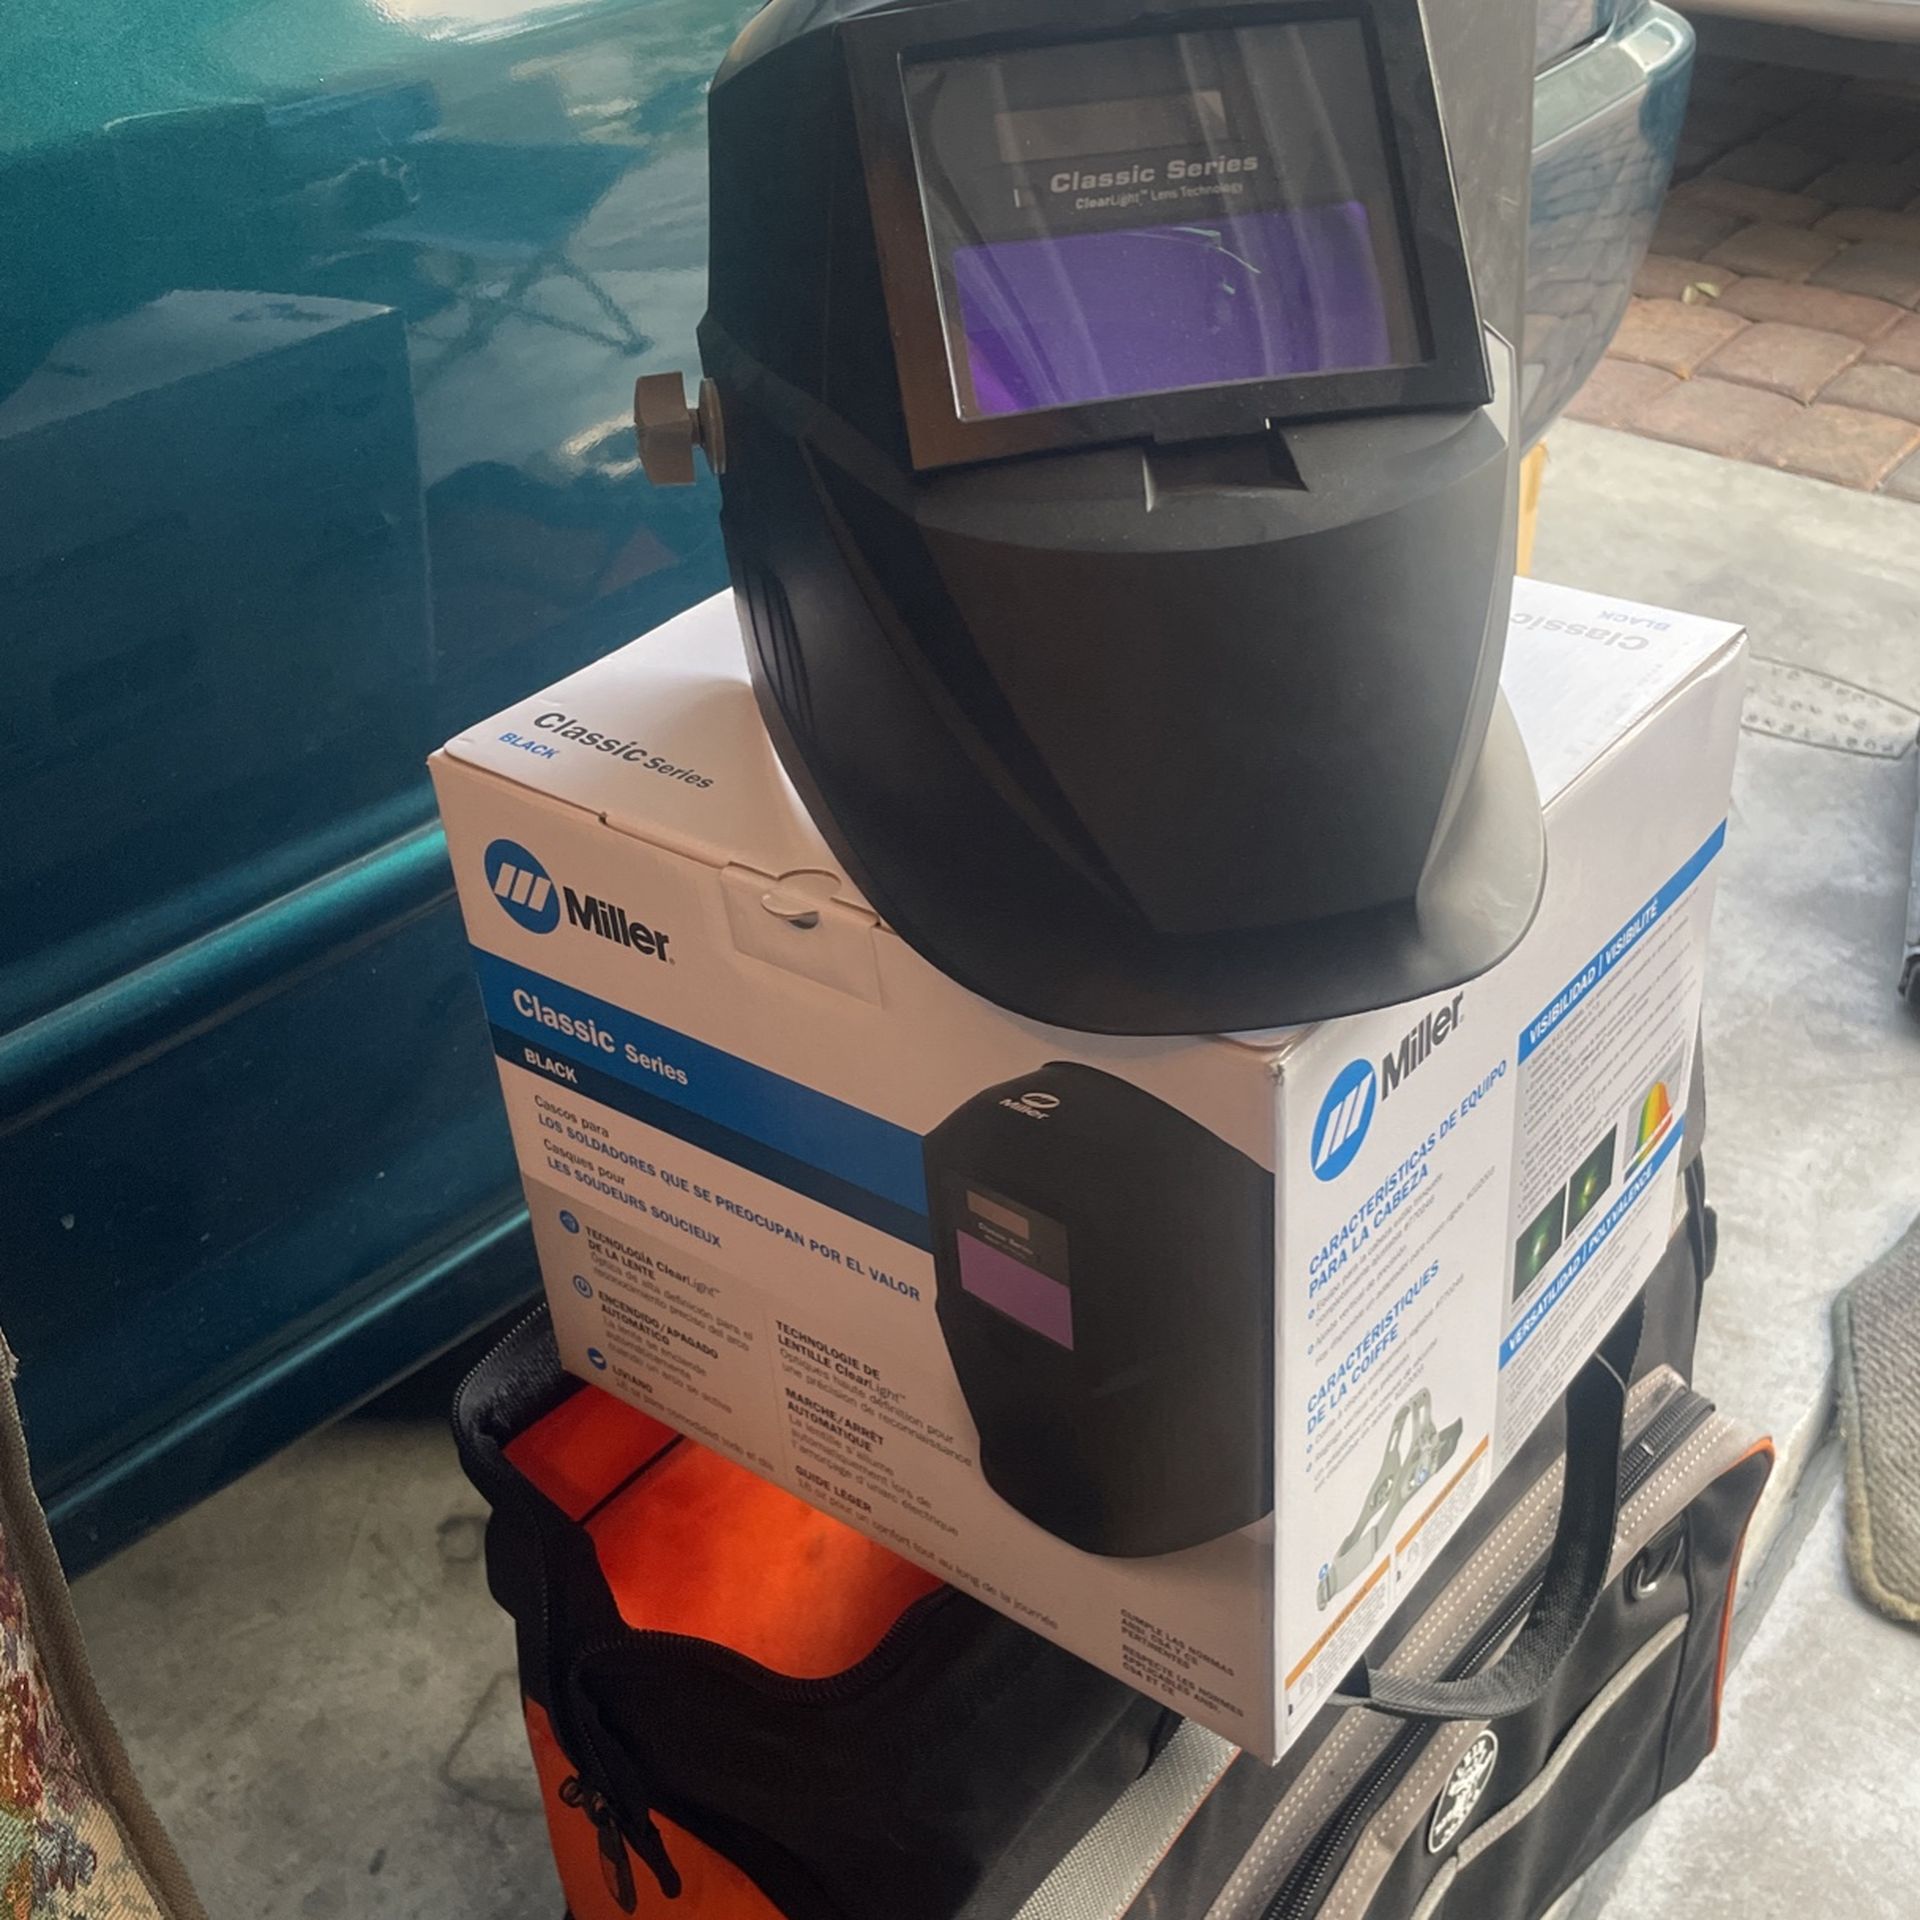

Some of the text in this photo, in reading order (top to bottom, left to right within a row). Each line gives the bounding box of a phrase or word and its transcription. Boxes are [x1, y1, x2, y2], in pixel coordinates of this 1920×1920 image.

[1050, 155, 1258, 193] Classic Series
[1150, 184, 1179, 201] Lens
[1510, 612, 1649, 650] Classic
[1597, 610, 1671, 631] BLACK
[499, 732, 560, 760] BLACK
[534, 712, 648, 763] Classic
[563, 886, 670, 962] Miller
[1529, 967, 1597, 1044] VISIBILIDAD
[1605, 899, 1659, 965] VISIBILITÉ
[513, 989, 689, 1086] Classic Series
[524, 1048, 579, 1084] BLACK
[1382, 991, 1464, 1102] Miller
[534, 1094, 610, 1139] Cascos para
[543, 1137, 626, 1186] Casques pour
[1309, 1132, 1437, 1276] CARACTERÍSTICAS
[1439, 1109, 1458, 1140] DE
[1460, 1059, 1507, 1118] EQUIPO
[538, 1113, 920, 1301] LOS SOLDADORES QUE SE PREOCUPAN POR EL VALOR
[547, 1156, 722, 1249] LES SOUDEURS SOUCIEUX
[1309, 1248, 1348, 1300] PARA
[1352, 1225, 1369, 1254] LA
[1373, 1163, 1429, 1229] CABEZA
[776, 1320, 881, 1381] TECHNOLOGIE DE
[777, 1334, 831, 1369] LENTILLE
[1307, 1259, 1440, 1413] CARACTÉRISTIQUES
[1306, 1322, 1400, 1435] DE LA COIFFE
